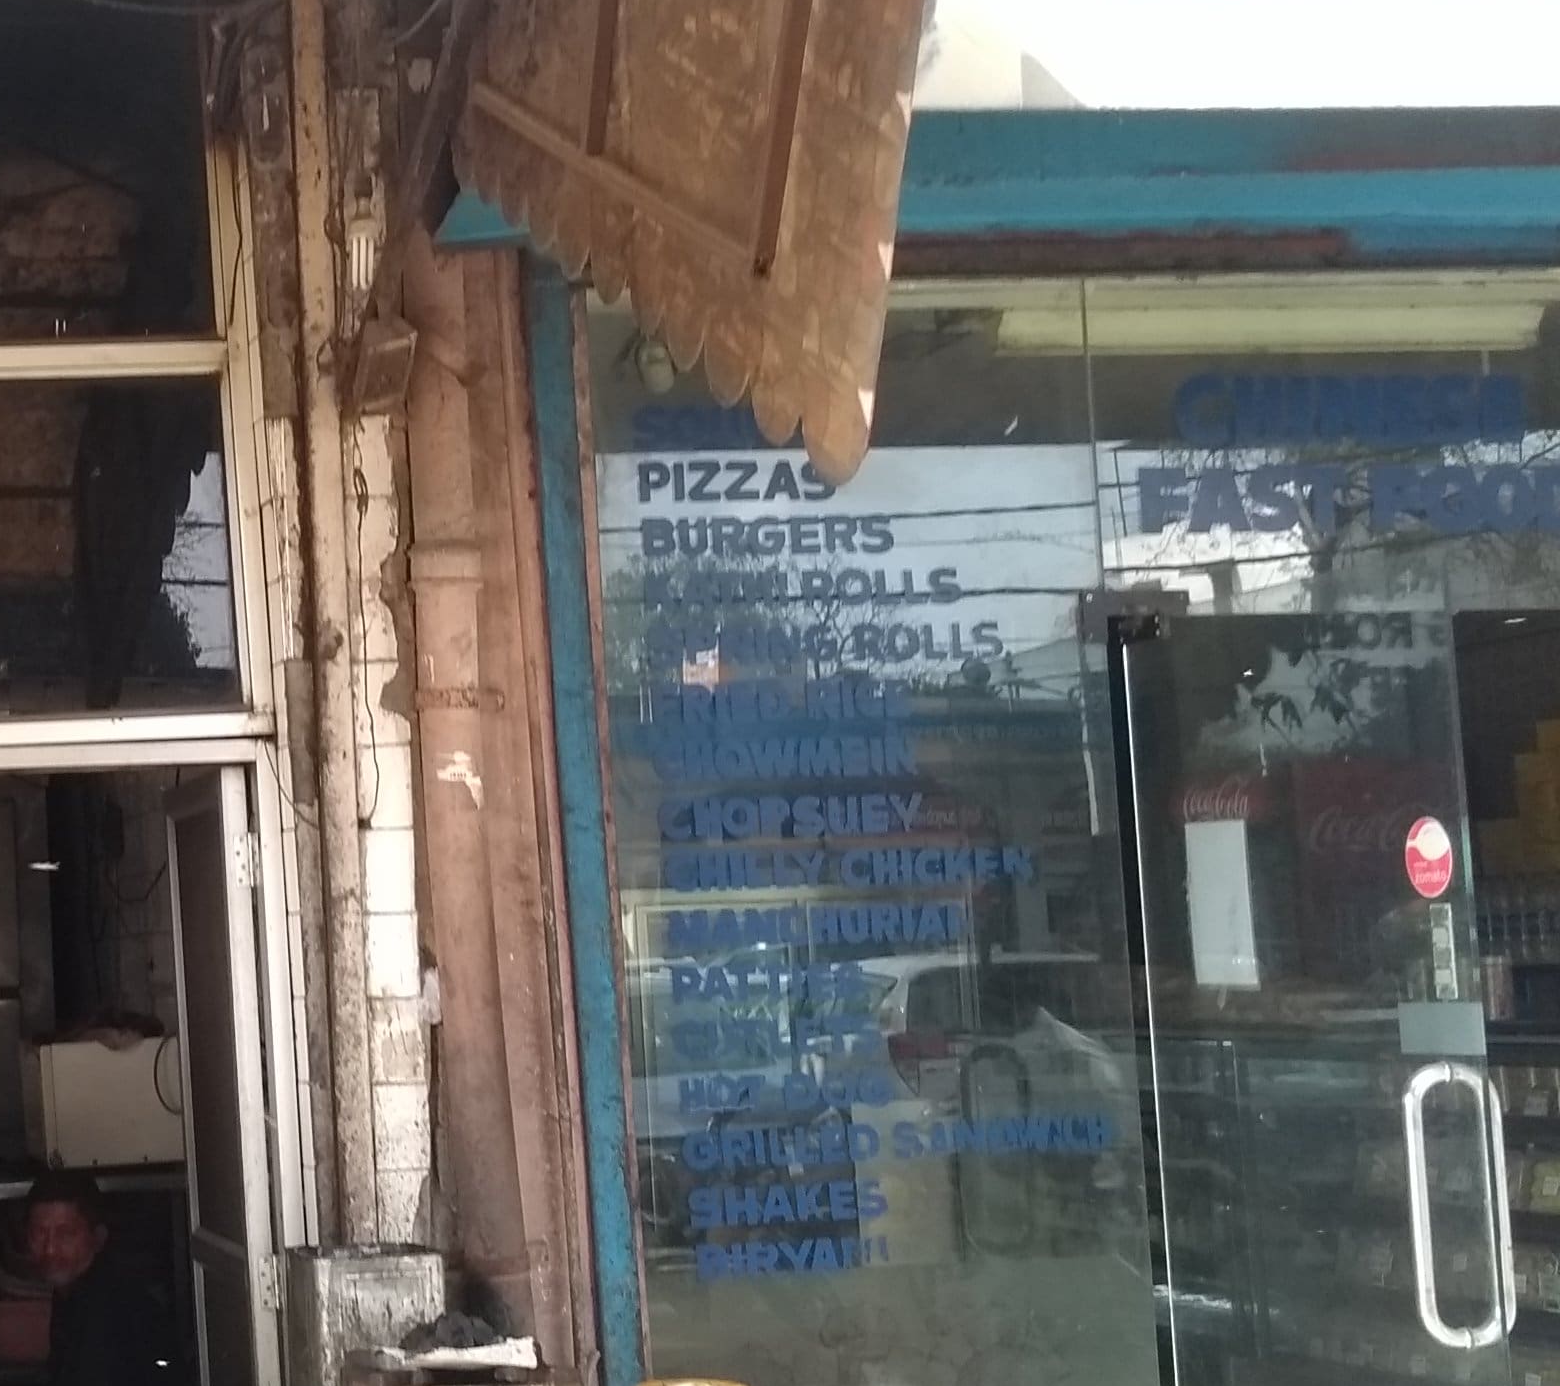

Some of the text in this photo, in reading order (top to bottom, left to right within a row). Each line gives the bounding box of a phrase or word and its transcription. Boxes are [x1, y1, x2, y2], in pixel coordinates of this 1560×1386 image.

[637, 458, 838, 502] PIZZAS
[1138, 465, 1340, 533] FAST
[640, 515, 895, 558] BURGERS
[798, 566, 962, 606] ROLLS
[645, 620, 1005, 669] SPRING ROLLS
[651, 679, 913, 722] FRIED RICE
[653, 737, 919, 781] CHOWMEIN
[658, 791, 924, 841] CHOPSUEY
[662, 845, 1035, 890] CHILLY CHICKEN
[679, 1069, 894, 1112] HOT DOG
[681, 1115, 1114, 1172] GRILLED SANDWICH
[687, 1180, 889, 1231] SHAKES
[695, 1236, 890, 1281] BIRYANI
